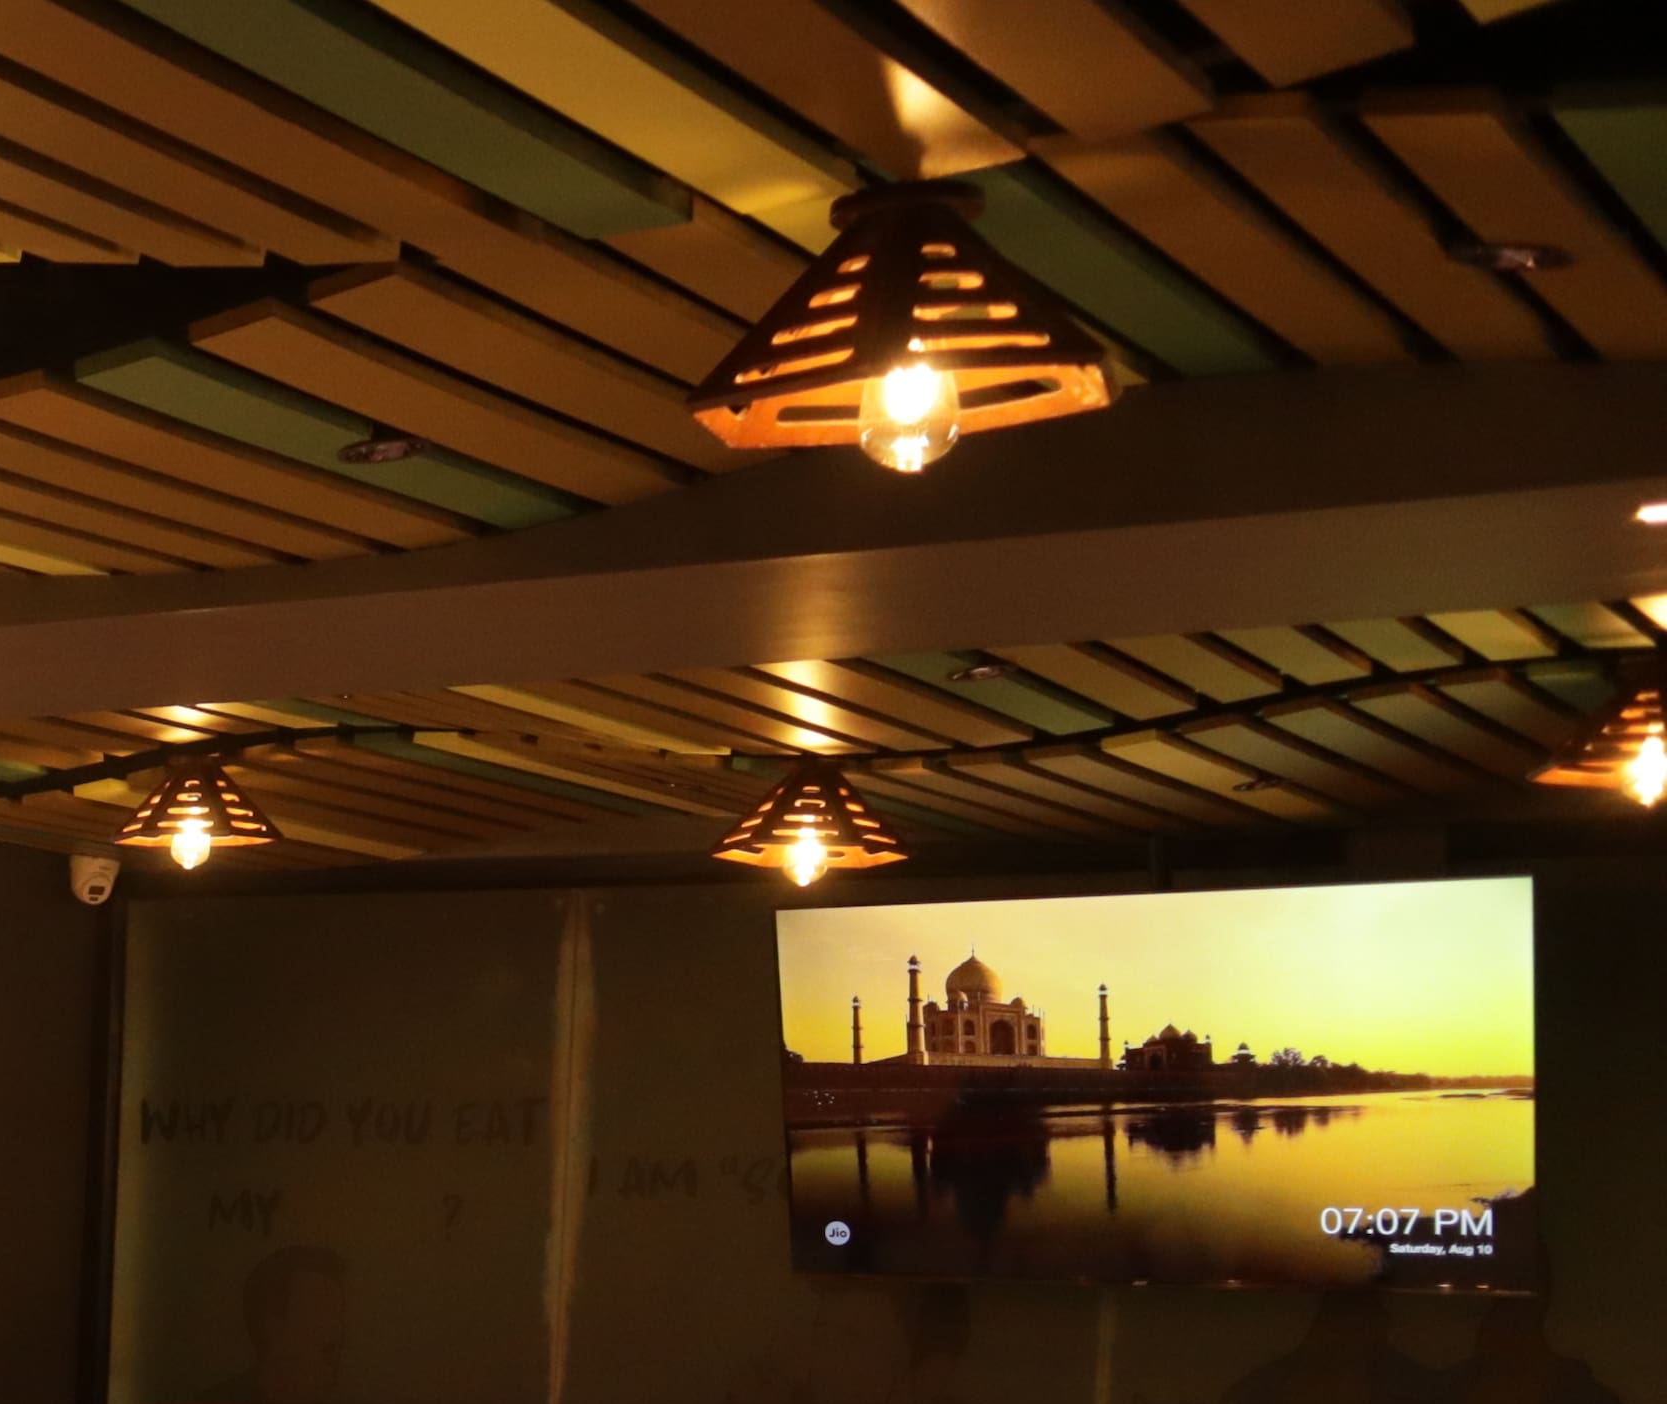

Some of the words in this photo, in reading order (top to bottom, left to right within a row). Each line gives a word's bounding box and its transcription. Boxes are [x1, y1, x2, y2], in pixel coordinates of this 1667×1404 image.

[255, 1099, 328, 1145] DID
[347, 1098, 432, 1149] YOU
[454, 1097, 546, 1146] EAT
[1320, 1207, 1420, 1236] 07:07
[1434, 1208, 1493, 1236] PM
[829, 1228, 847, 1238] Jio
[1389, 1243, 1446, 1256] Saturday,
[1449, 1244, 1474, 1257] Aug
[1477, 1244, 1493, 1255] 10
